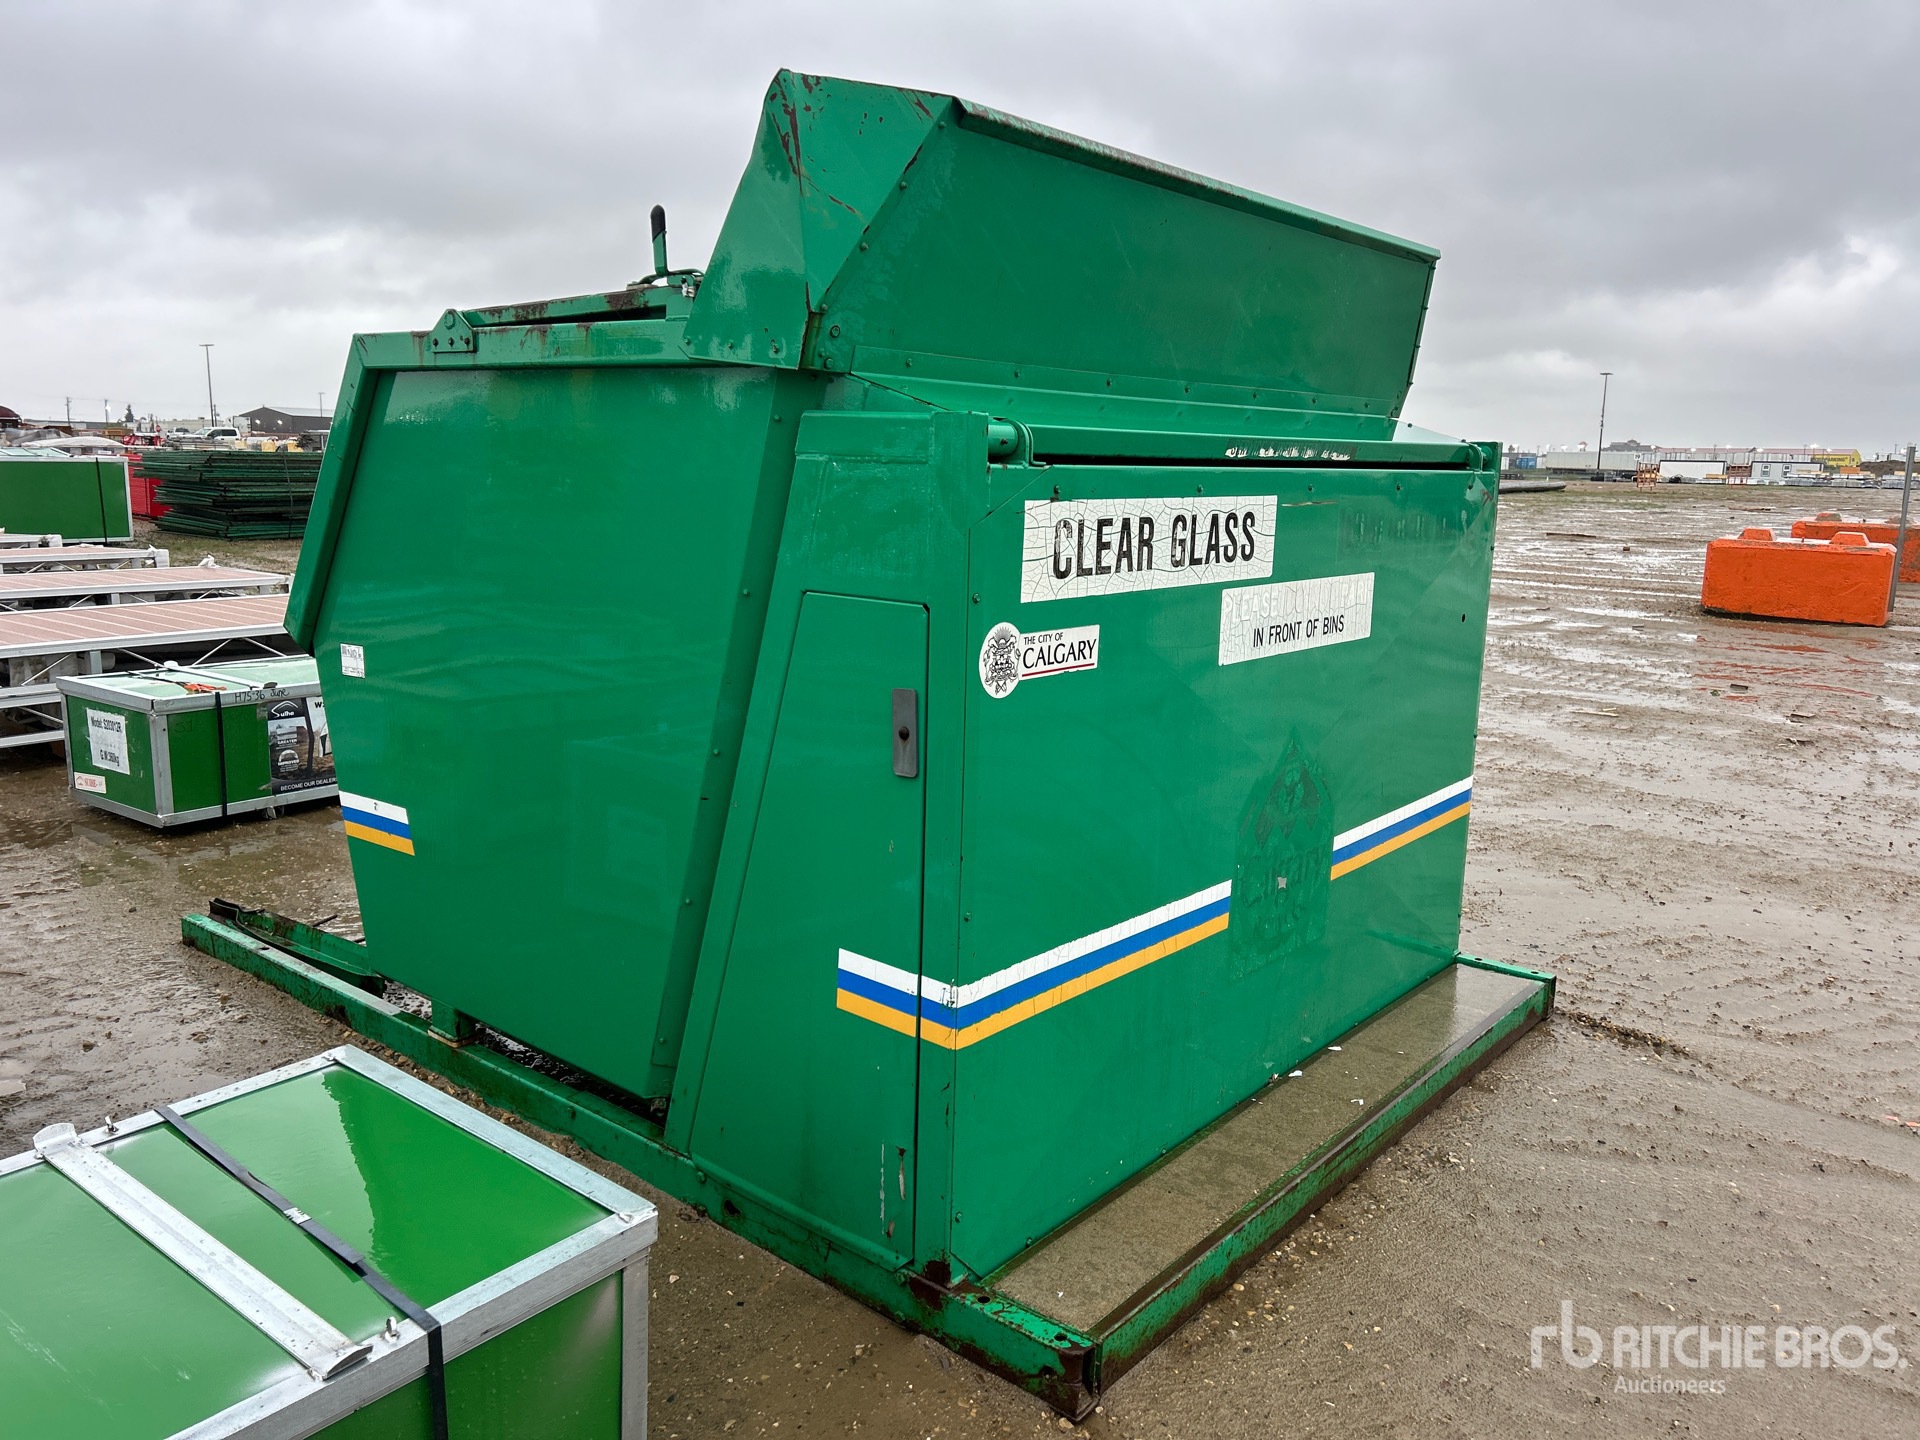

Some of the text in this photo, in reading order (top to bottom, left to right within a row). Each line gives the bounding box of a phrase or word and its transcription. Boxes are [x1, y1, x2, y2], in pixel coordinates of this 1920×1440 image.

[1052, 511, 1256, 580] CLEAR GLASS
[1023, 632, 1064, 645] THE CITY OF
[1253, 614, 1345, 648] IN FRONT OF BINS
[1022, 638, 1097, 669] CALGARY
[234, 692, 266, 704] H75-36
[280, 782, 304, 792] BECOME
[303, 780, 316, 788] OUR
